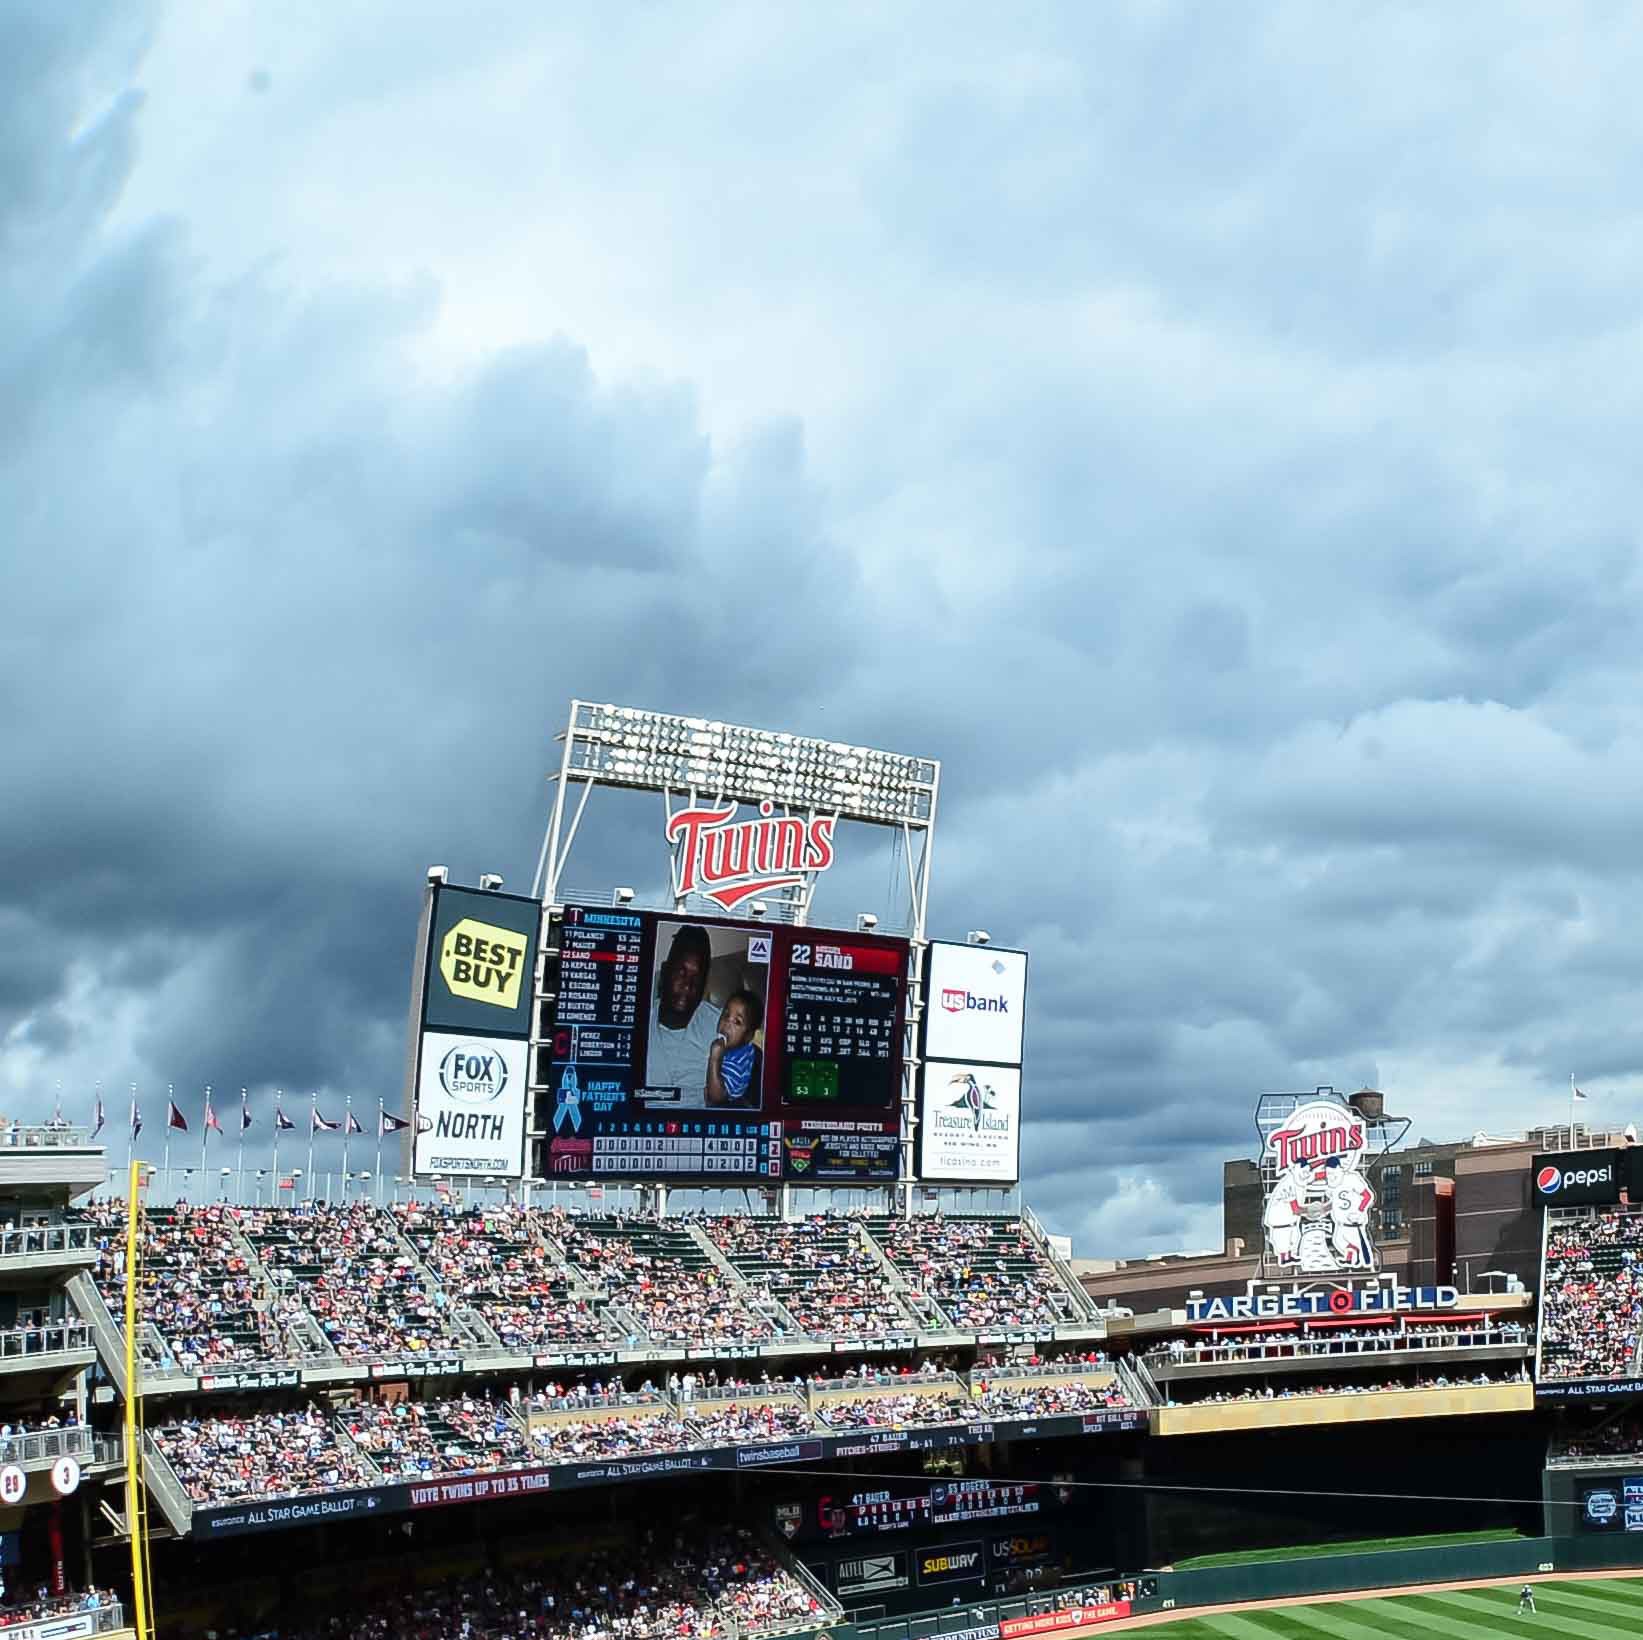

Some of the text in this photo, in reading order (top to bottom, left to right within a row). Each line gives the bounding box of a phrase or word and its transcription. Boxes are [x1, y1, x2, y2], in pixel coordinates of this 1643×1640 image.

[667, 801, 834, 900] Twins
[583, 913, 641, 928] MINNESOTA
[453, 932, 522, 971] BEST
[791, 943, 811, 965] 22
[452, 958, 514, 994] BUY
[453, 1054, 494, 1082] FOX
[452, 1081, 494, 1094] SPORTS
[581, 1091, 626, 1101] FATHER'S
[587, 1081, 621, 1092] HAPPY
[593, 1102, 613, 1112] DAY
[436, 1109, 505, 1141] NORTH
[932, 1110, 1010, 1132] Treasure Island
[1269, 1122, 1364, 1170] Twins
[939, 1156, 1001, 1168] ticasino.com
[1563, 1164, 1612, 1189] pepsi
[1185, 1286, 1459, 1321] TARGET FIELD
[1567, 1386, 1584, 1395] ALL
[1585, 1385, 1606, 1394] STAR
[1606, 1383, 1634, 1393] GAME
[881, 1432, 909, 1443] BAUER
[738, 1446, 801, 1464] twinsbaseball
[63, 1467, 71, 1484] 3
[606, 1466, 621, 1477] ALL
[621, 1465, 641, 1477] STAR
[642, 1462, 665, 1474] GAME
[665, 1458, 692, 1472] BALLOT
[410, 1473, 551, 1505] VOTE TWINS UP TO TIMES
[959, 1479, 990, 1492] ROGERS
[864, 1490, 891, 1503] BAUER
[247, 1498, 355, 1524] ALL STAR GAME BALLOT
[922, 1552, 979, 1574] SUBWAY
[973, 1626, 1000, 1640] FUND
[1003, 1621, 1033, 1635] GETTING
[1082, 1611, 1098, 1621] THE
